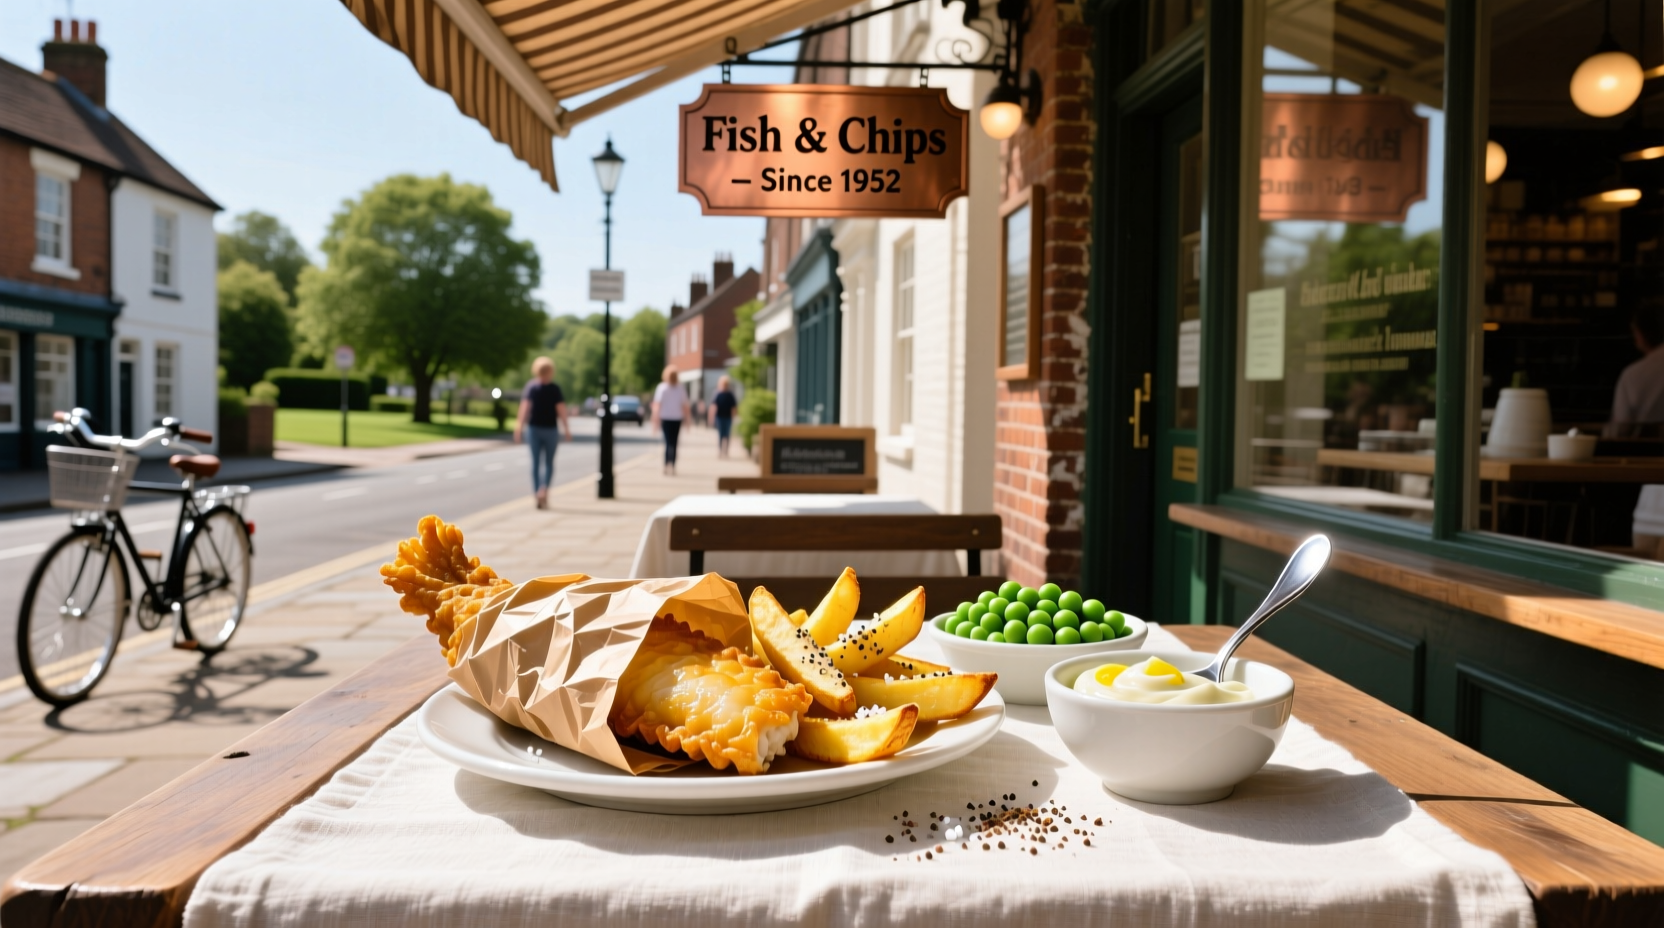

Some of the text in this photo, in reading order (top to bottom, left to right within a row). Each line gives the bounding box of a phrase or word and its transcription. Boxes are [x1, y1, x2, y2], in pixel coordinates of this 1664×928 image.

[702, 115, 947, 164] Fish & Chips
[761, 167, 832, 192] Since
[840, 168, 901, 193] 1952
